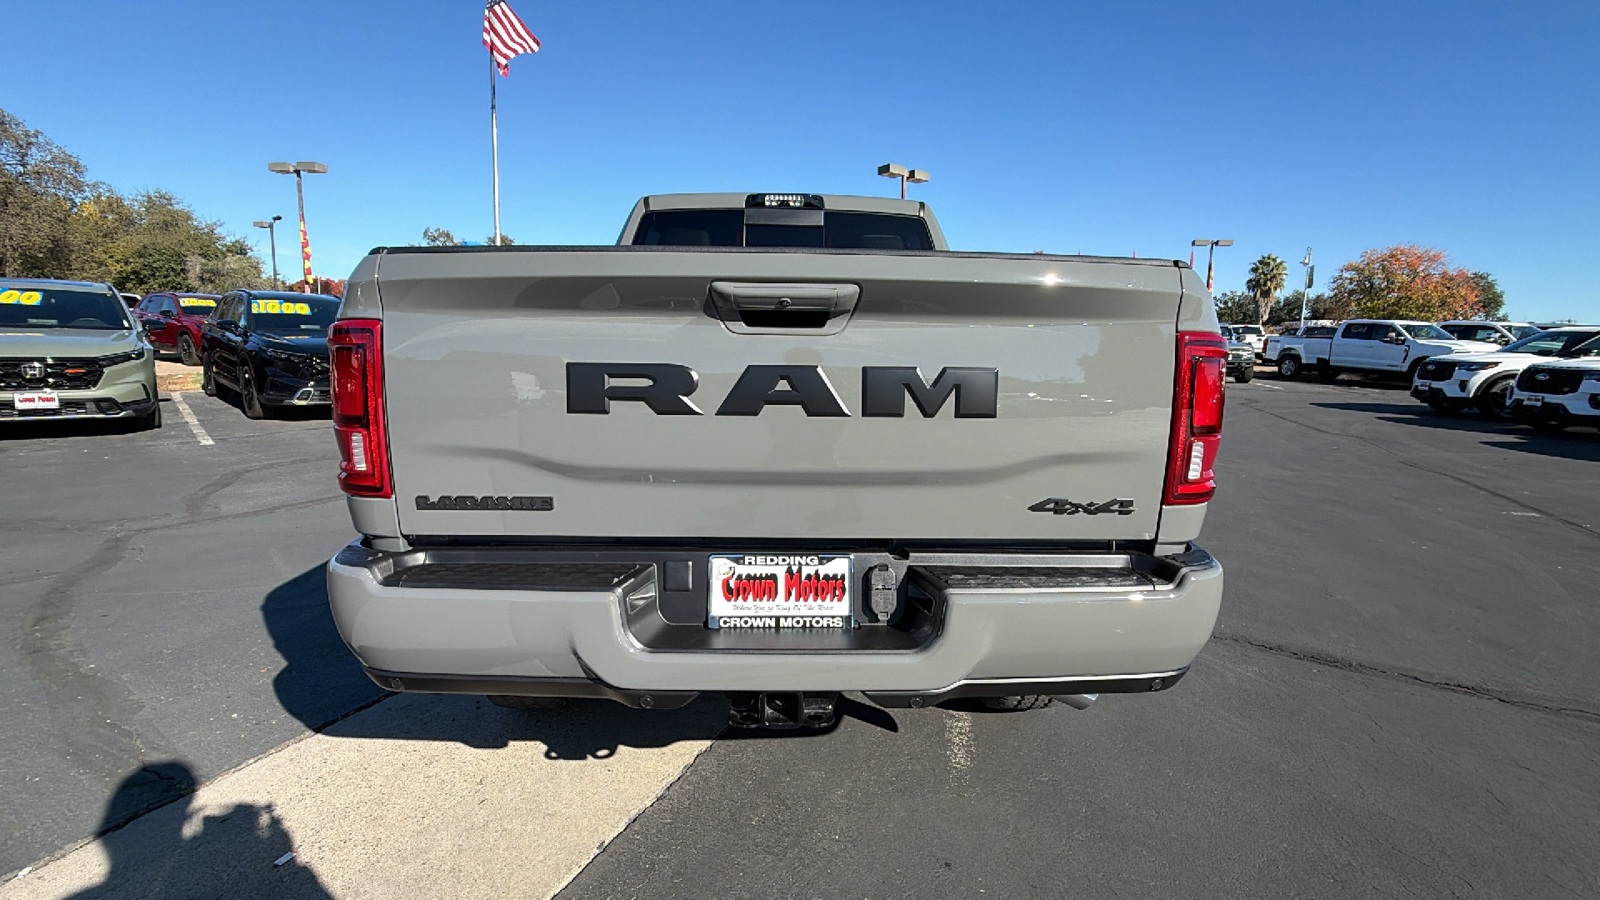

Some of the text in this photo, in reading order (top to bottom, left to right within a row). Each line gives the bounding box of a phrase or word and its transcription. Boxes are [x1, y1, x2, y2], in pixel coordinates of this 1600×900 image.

[566, 361, 999, 418] RAM
[1027, 497, 1136, 515] 4x4
[744, 556, 819, 566] REDDING
[721, 569, 847, 602] Crown Motors
[753, 604, 774, 614] Youre
[719, 617, 843, 628] CROWN MOTORS
